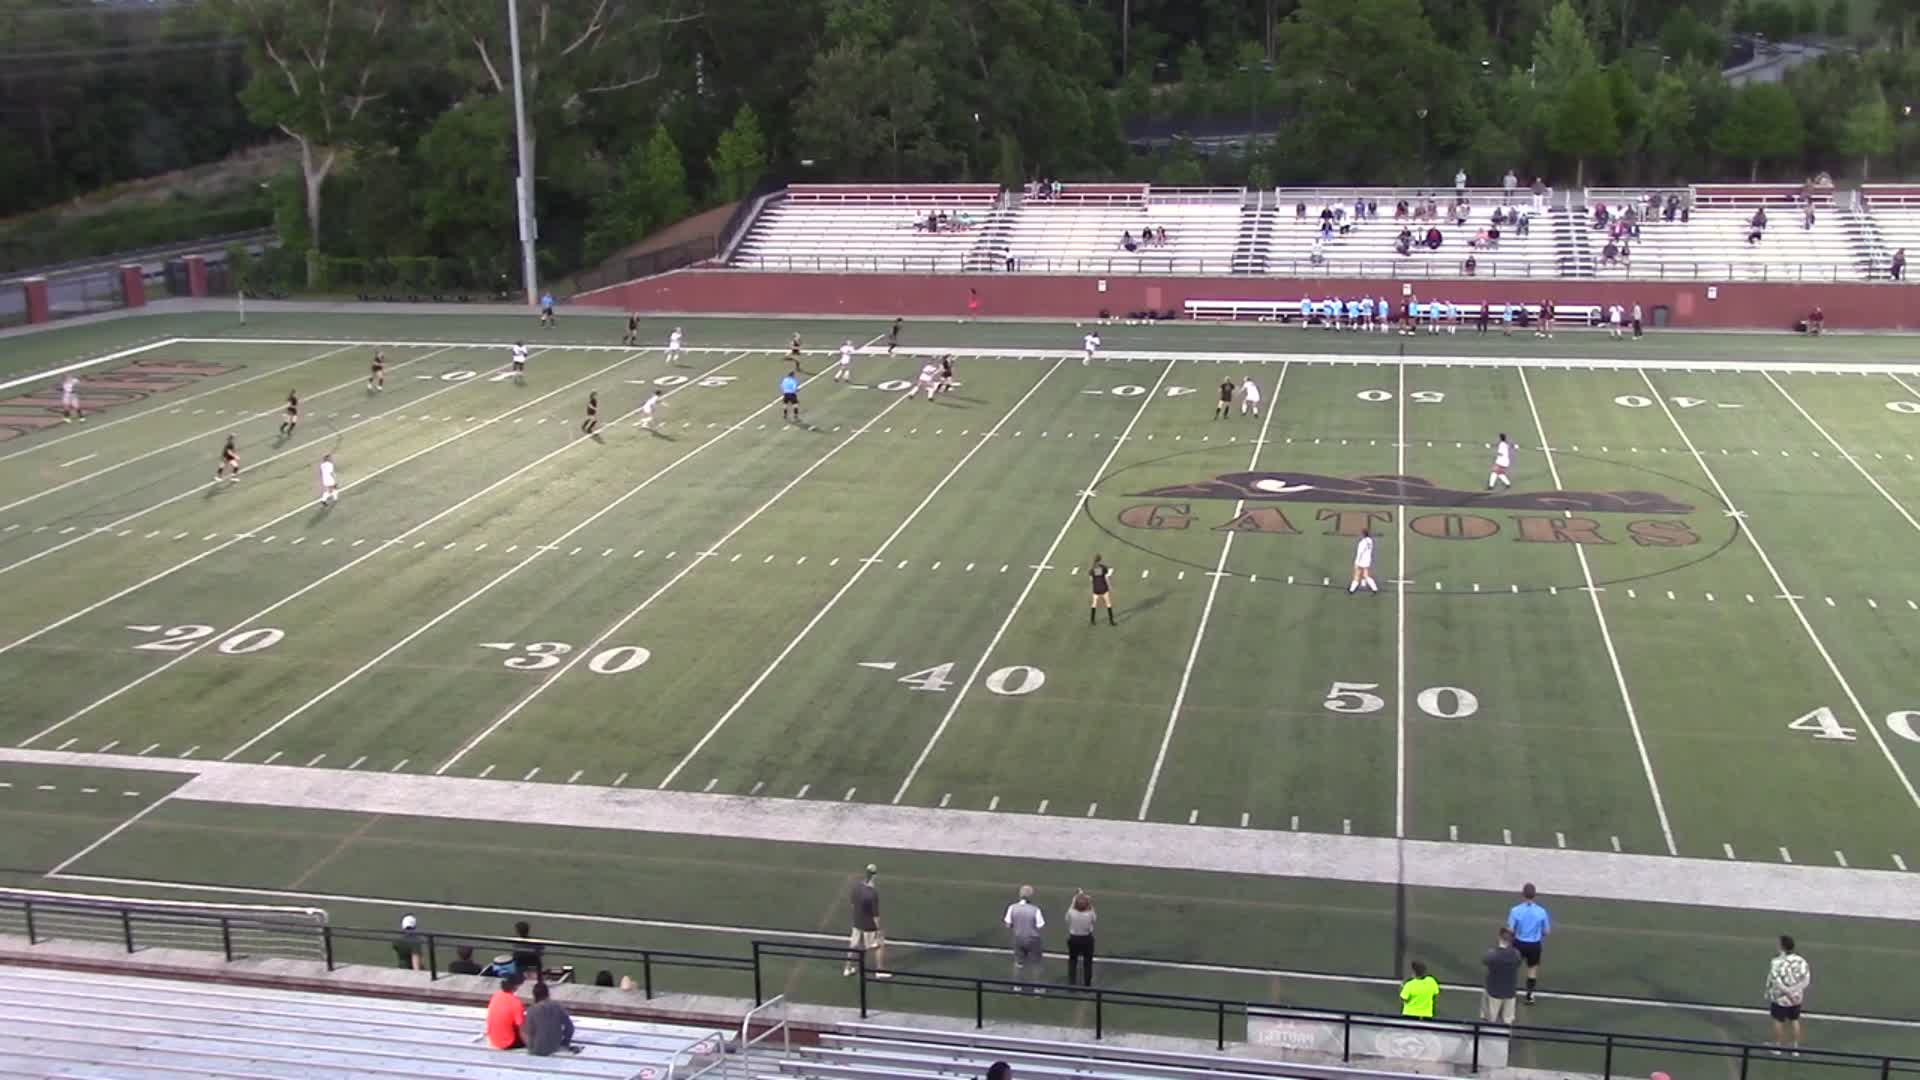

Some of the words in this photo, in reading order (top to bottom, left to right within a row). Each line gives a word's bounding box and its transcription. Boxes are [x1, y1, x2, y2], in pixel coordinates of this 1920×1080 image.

[1357, 389, 1445, 403] 50
[1118, 504, 1701, 546] GATORS
[134, 624, 285, 654] 20
[504, 641, 652, 673] 30
[898, 662, 1046, 696] 40
[1322, 681, 1480, 718] 50
